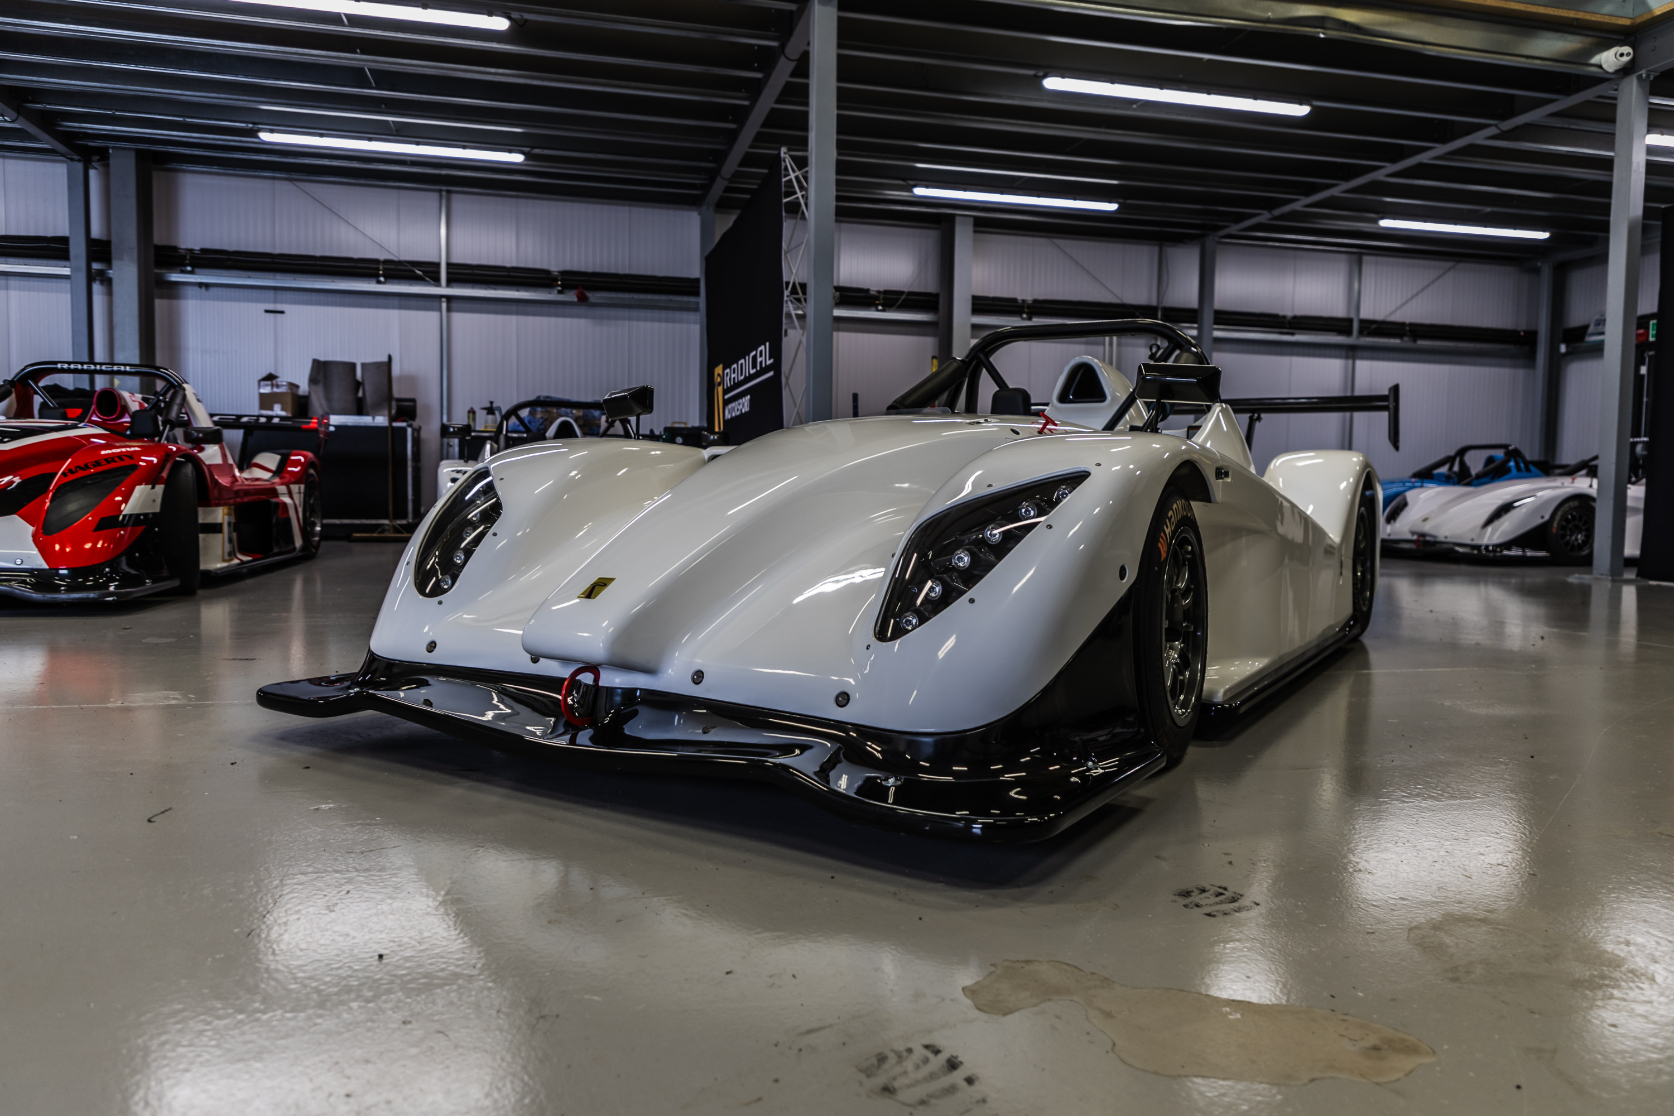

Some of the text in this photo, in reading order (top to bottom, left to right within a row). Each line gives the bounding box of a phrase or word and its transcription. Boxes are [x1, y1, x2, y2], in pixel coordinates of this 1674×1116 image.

[57, 362, 136, 373] RADICAL
[723, 341, 774, 390] RADICAL
[724, 394, 751, 421] MOTORSPORT
[100, 446, 142, 455] MOTUL
[60, 453, 135, 478] HAGERTY
